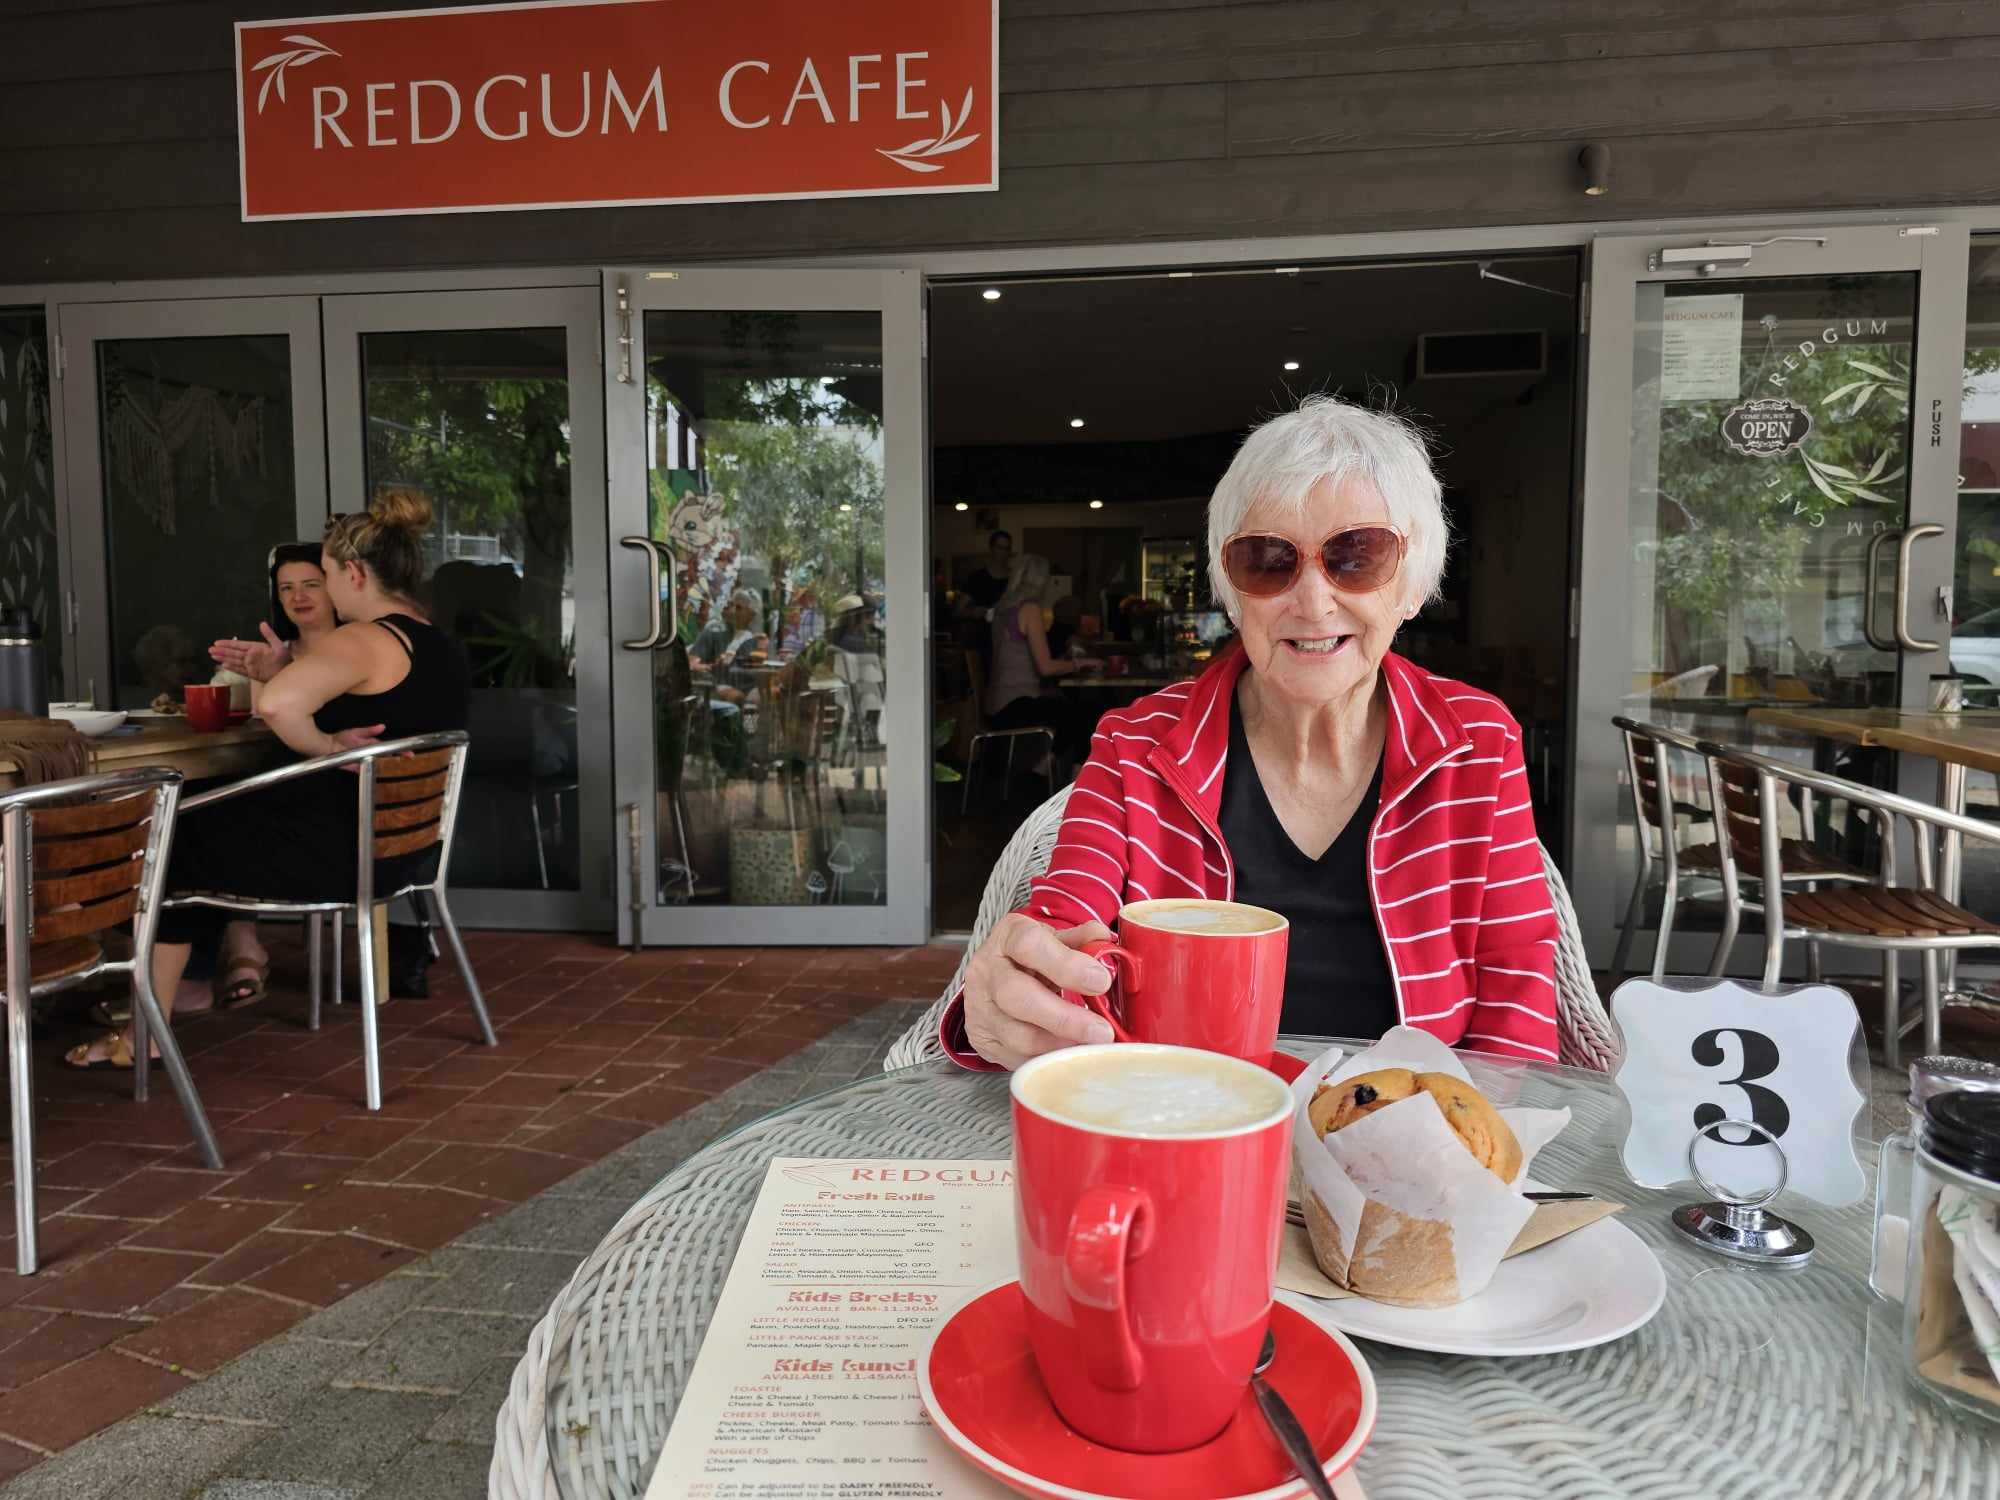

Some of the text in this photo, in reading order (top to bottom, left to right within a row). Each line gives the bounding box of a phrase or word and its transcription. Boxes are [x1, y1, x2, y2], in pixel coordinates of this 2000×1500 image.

[312, 50, 930, 149] REDGUM CAFE
[1769, 319, 1887, 388] REDGUM
[1741, 421, 1793, 439] OPEN
[1931, 399, 1942, 447] PUSH
[1691, 1027, 1791, 1147] 3
[818, 1192, 936, 1201] Fresh Rolls
[789, 1291, 938, 1304] Kids Brekky
[773, 1359, 834, 1372] Kids
